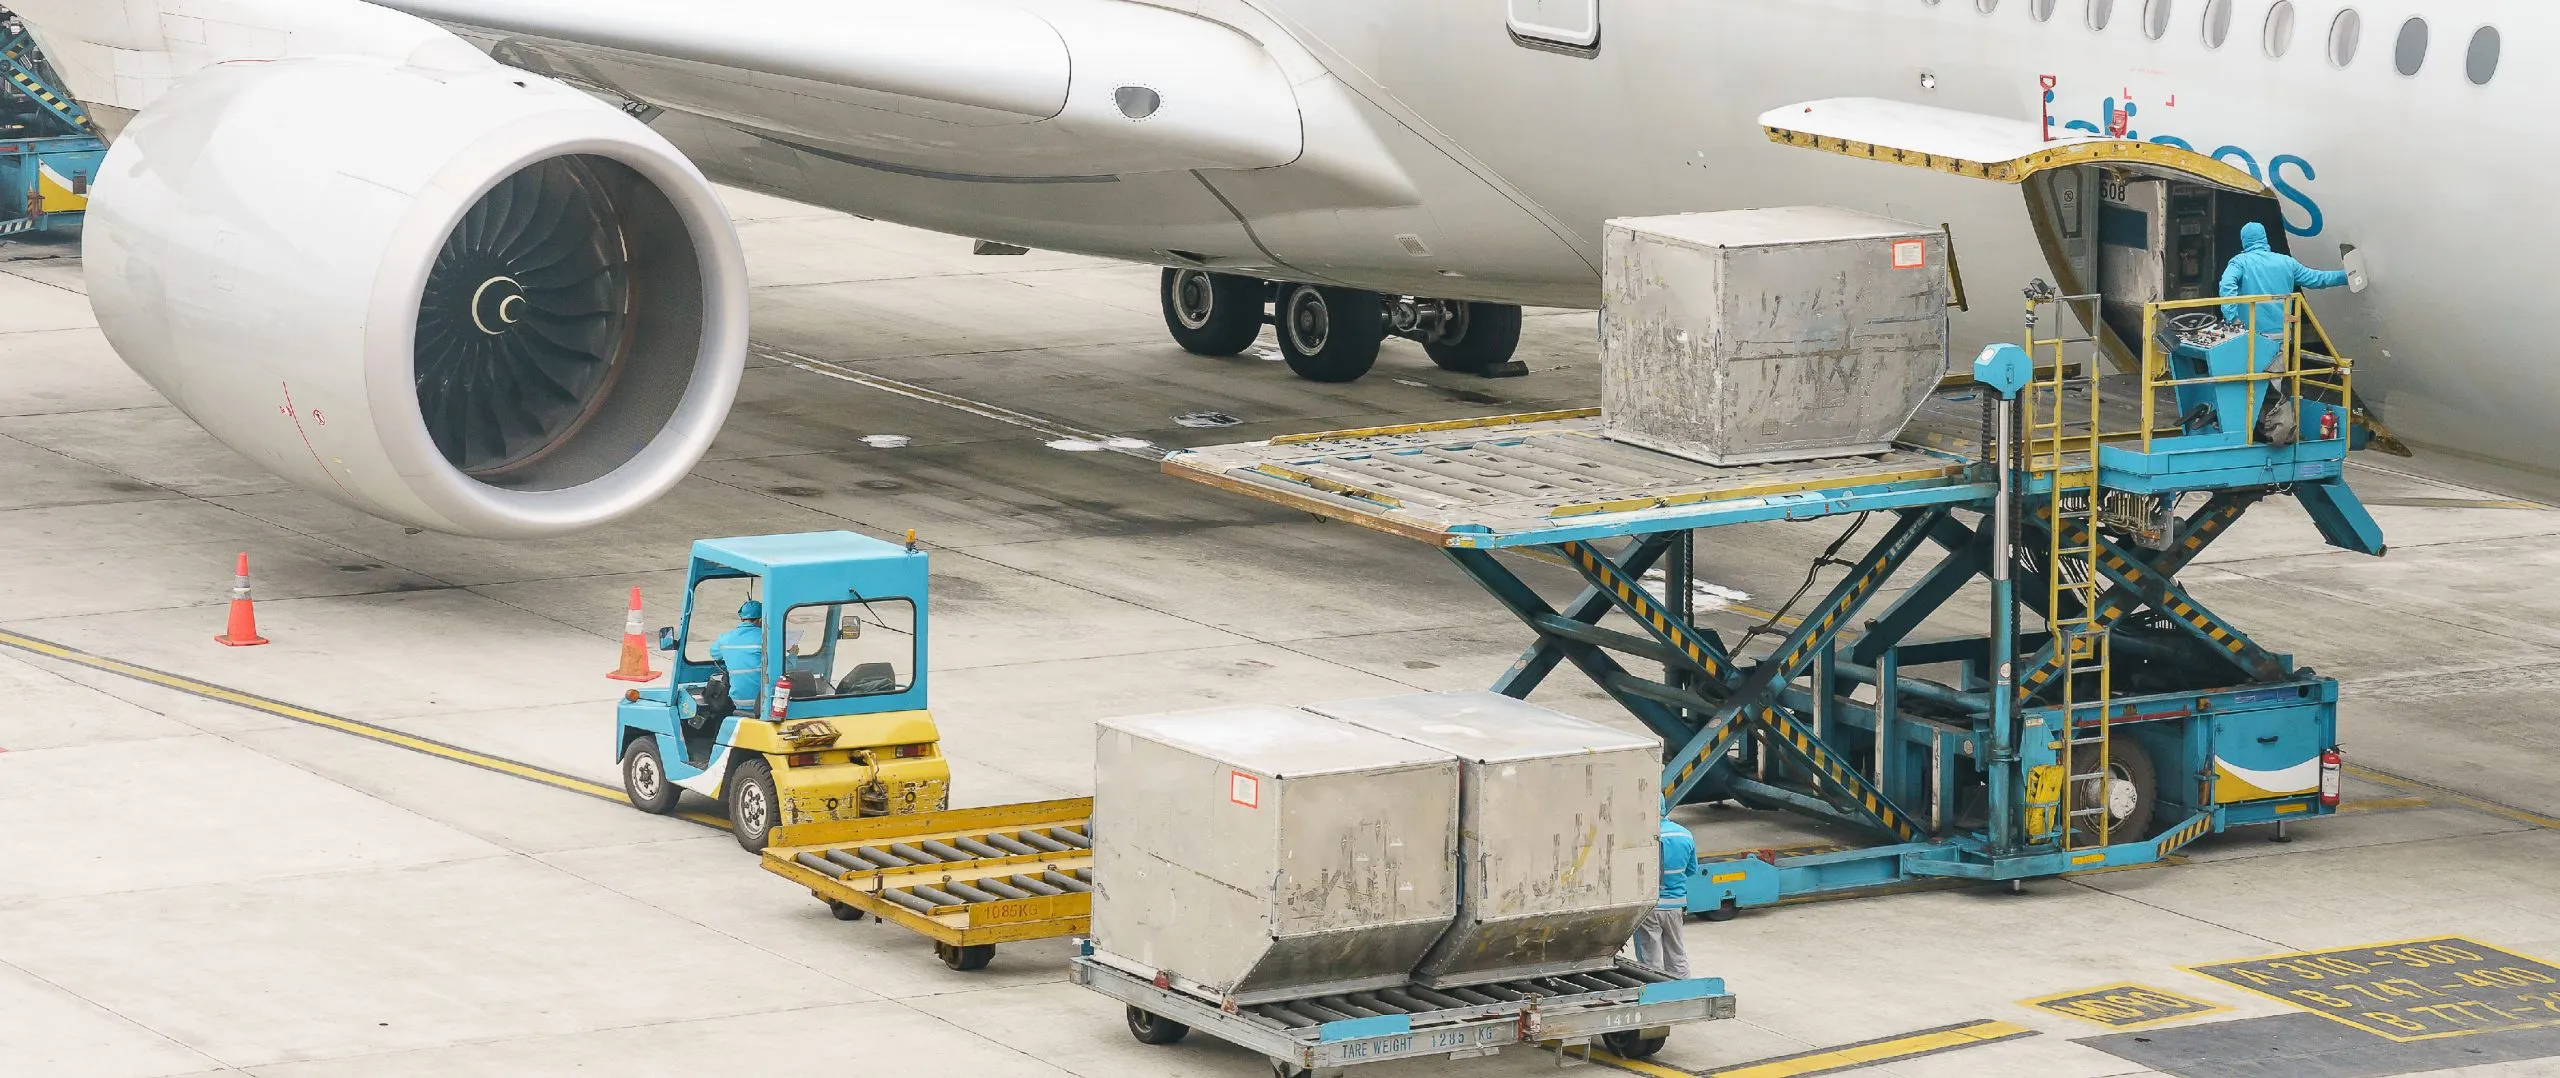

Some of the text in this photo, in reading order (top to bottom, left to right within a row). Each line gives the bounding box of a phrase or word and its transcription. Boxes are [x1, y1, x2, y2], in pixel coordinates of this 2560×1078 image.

[983, 903, 1039, 920] 1085KG
[2230, 944, 2484, 986] A 310-300
[2287, 966, 2558, 1008] B 747-400
[2050, 991, 2192, 1022] MD90
[2360, 1011, 2429, 1032] B
[1342, 1026, 1493, 1059] TARE WEIGHT 1285 KG
